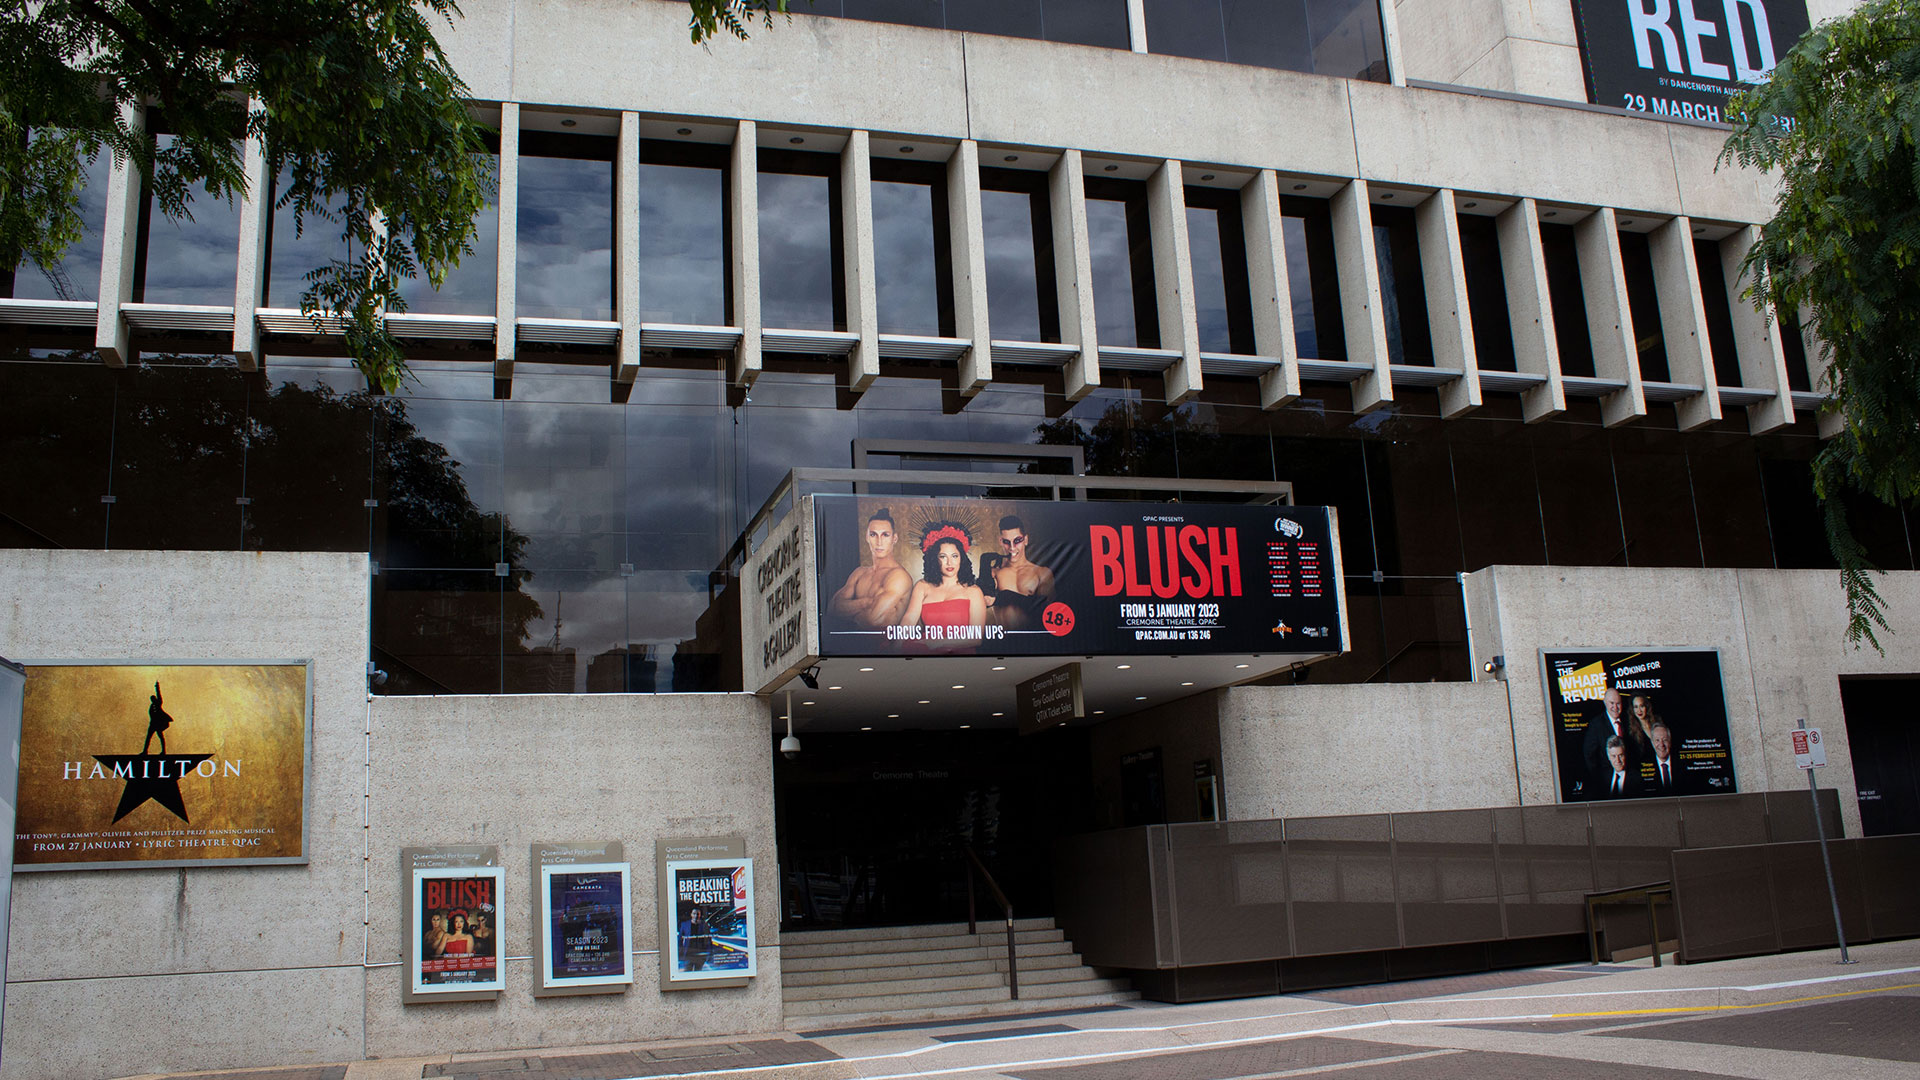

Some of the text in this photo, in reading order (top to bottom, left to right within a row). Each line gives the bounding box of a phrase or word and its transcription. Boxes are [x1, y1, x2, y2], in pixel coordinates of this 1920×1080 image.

[1626, 0, 1776, 85] RED
[1659, 77, 1669, 86] BY
[1670, 79, 1722, 95] DANCENORTH
[1623, 93, 1646, 112] 29
[1652, 97, 1719, 123] MARCH
[1089, 524, 1243, 599] BLUSH
[766, 567, 801, 625] THEATRE
[1044, 609, 1073, 628] 18+
[1120, 603, 1220, 618] FROM 5 JANUARY 2023
[1166, 618, 1197, 626] THEATRE,
[1198, 618, 1218, 626] QPAC
[886, 625, 1004, 640] CIRCUS FOR GROWN UPS
[1135, 630, 1211, 641] QPAC.COM.AU or 136 246
[1556, 667, 1574, 677] THE
[1613, 660, 1661, 678] LOOKING FOR
[1559, 672, 1607, 690] WHARF
[1615, 678, 1662, 690] ALBANESE
[1562, 686, 1606, 704] REVUE
[62, 759, 243, 780] HAMILTON
[33, 837, 261, 852] FROM 27 JANUARY LYRIC THEATRE, QPAC
[679, 877, 730, 893] BREAKING
[427, 880, 490, 910] BLUSH
[680, 890, 731, 904] THE CASTLE
[566, 935, 609, 945] SEASON 2023
